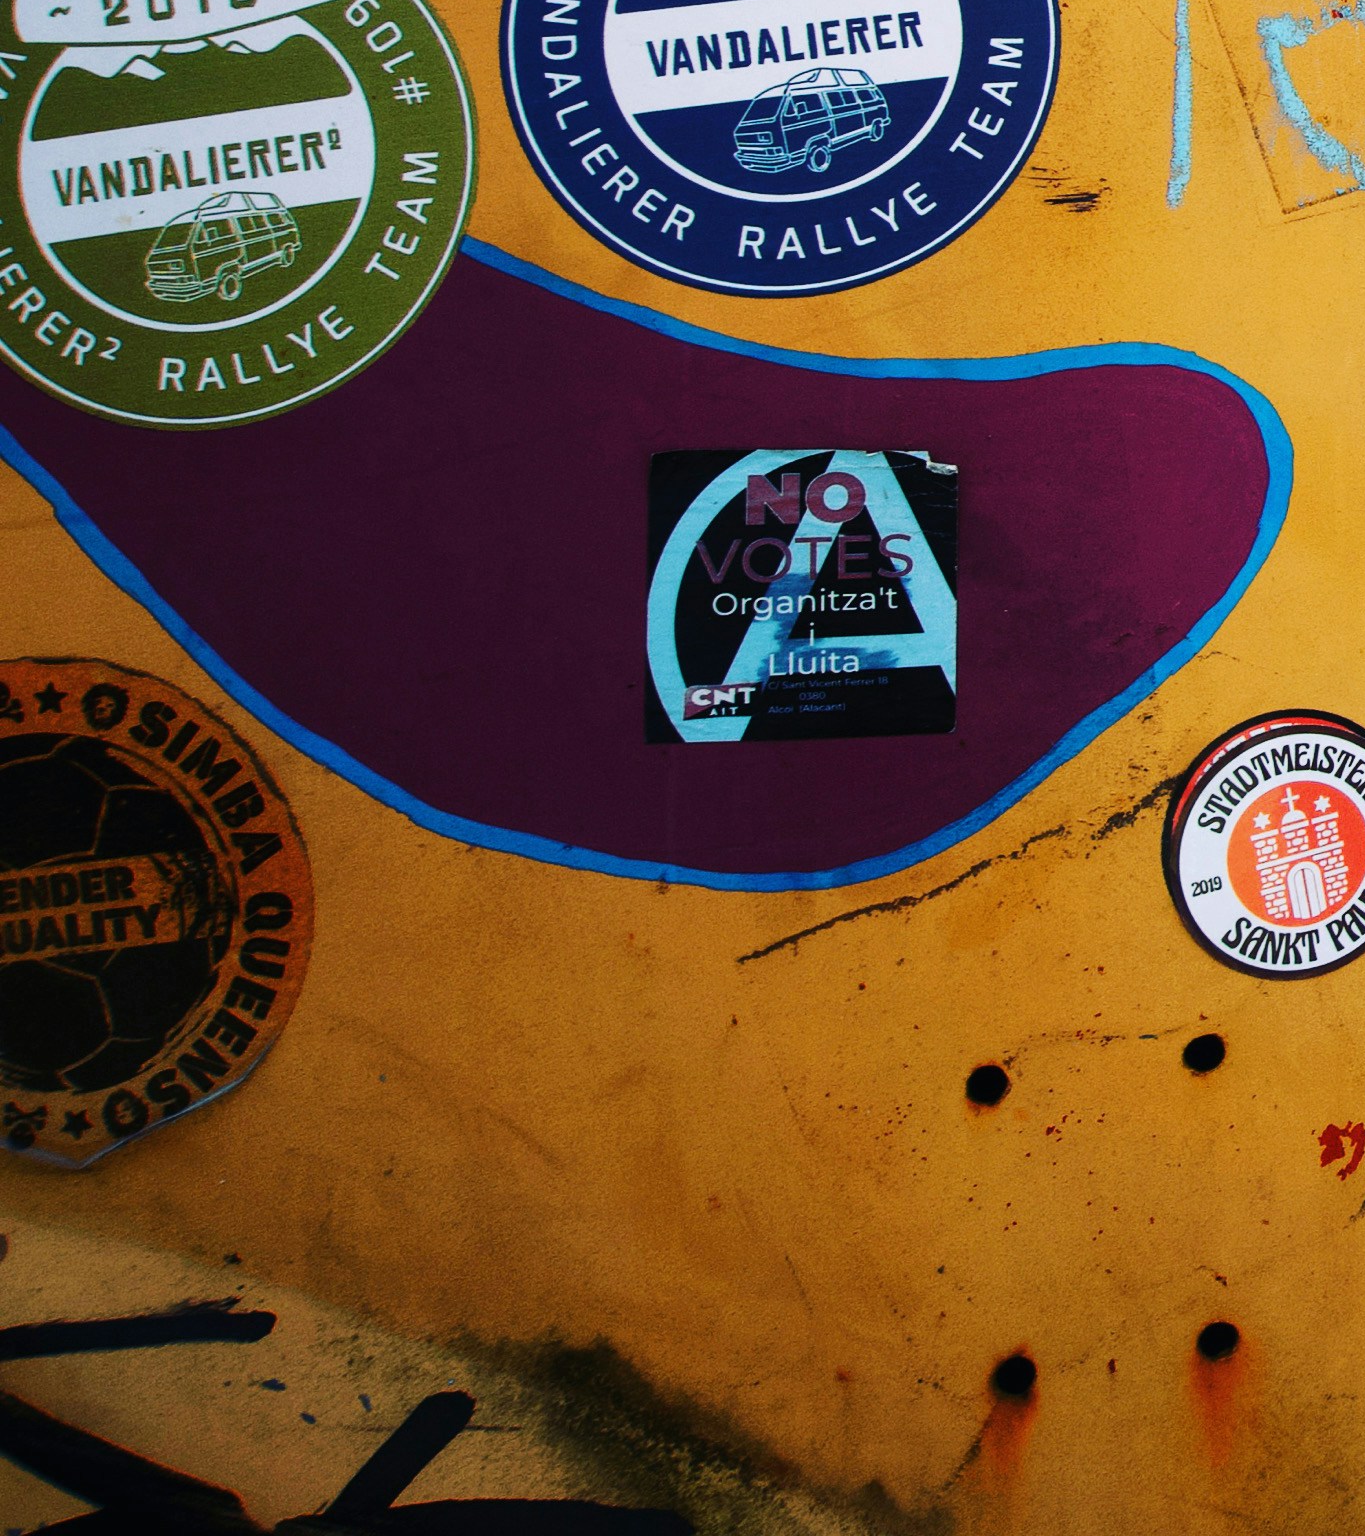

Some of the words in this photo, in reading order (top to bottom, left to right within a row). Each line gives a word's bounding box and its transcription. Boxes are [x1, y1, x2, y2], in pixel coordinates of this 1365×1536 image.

[647, 10, 924, 78] VANDALIERER
[738, 180, 938, 261] RALLYE
[949, 35, 1025, 161] TEAM
[158, 304, 355, 392] RALLYE
[364, 149, 440, 283] TEAM
[744, 470, 867, 526] NO
[696, 533, 914, 585] VOTES
[712, 587, 899, 622] Organitza't
[808, 622, 816, 647] i
[768, 649, 860, 677] Lluita
[691, 686, 757, 707] CNT
[710, 706, 738, 716] AIT
[129, 700, 284, 877] SIMBA
[0, 866, 137, 914] ENDER
[1190, 875, 1223, 898] 2019
[0, 903, 163, 954] UALITY
[1221, 916, 1321, 965] SANKT
[146, 891, 294, 1116] QUEENS
